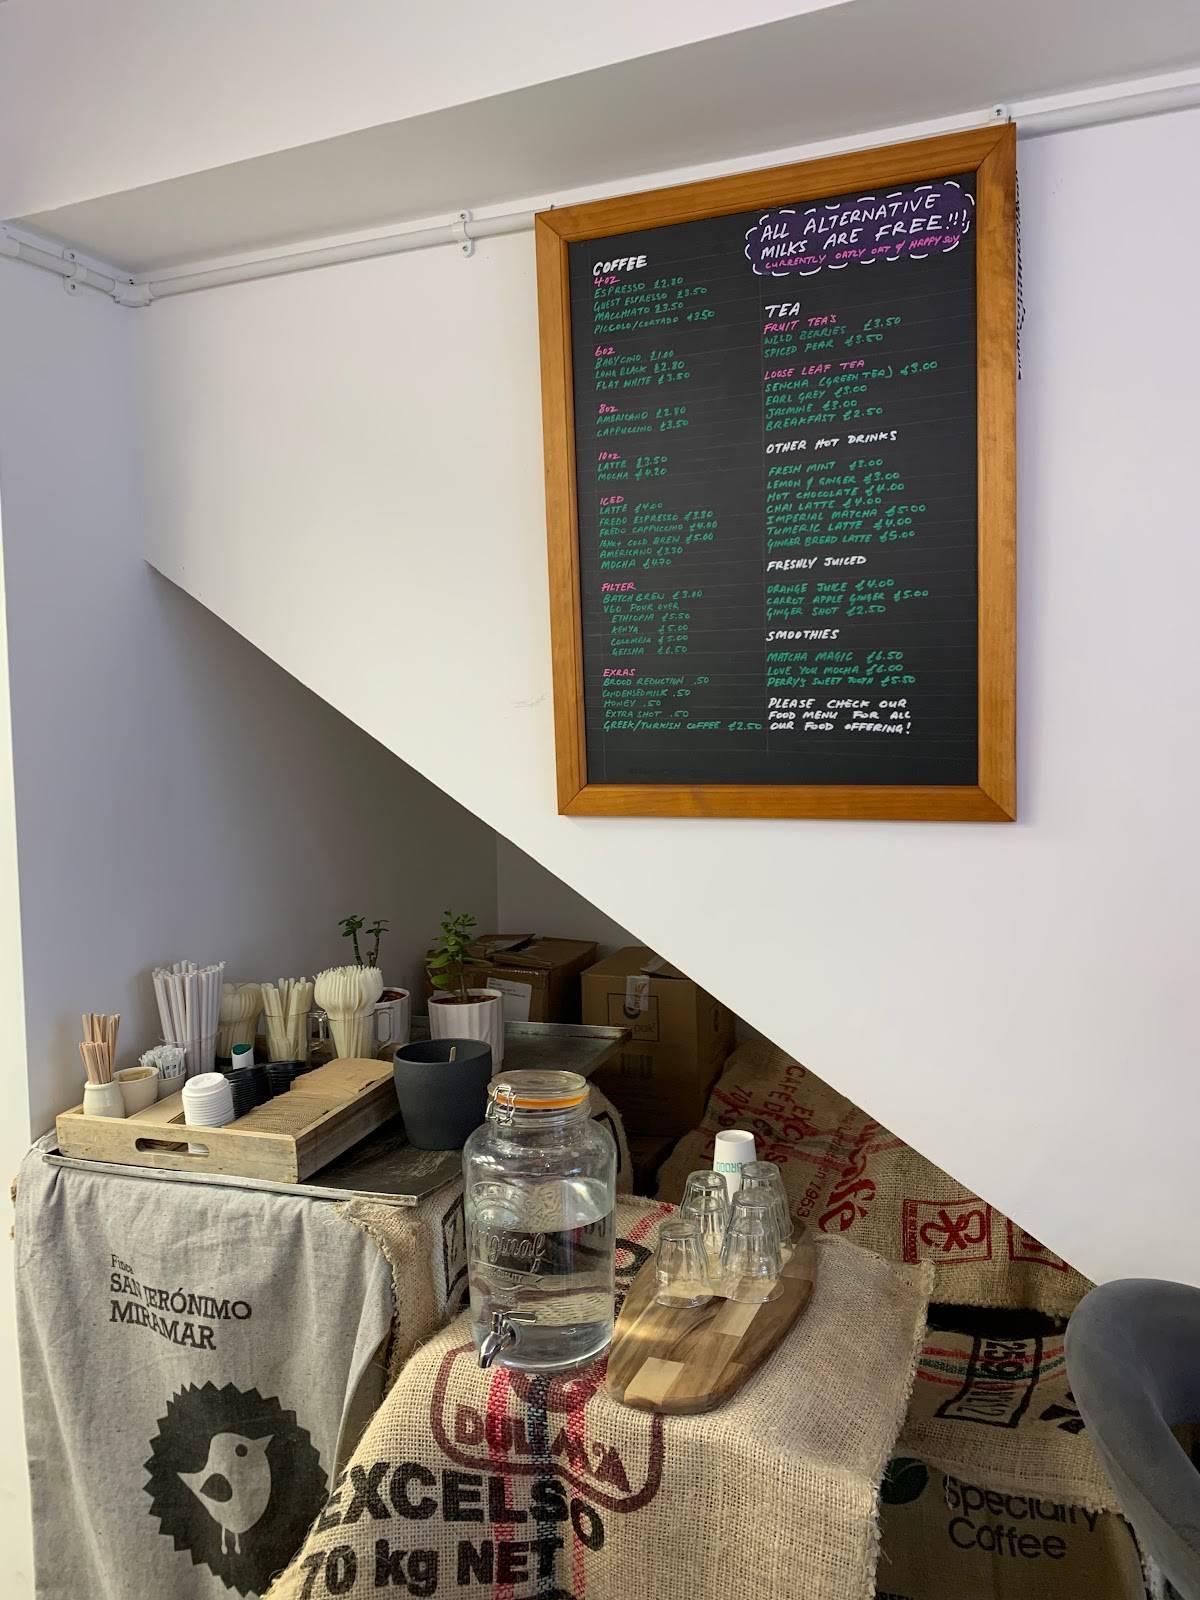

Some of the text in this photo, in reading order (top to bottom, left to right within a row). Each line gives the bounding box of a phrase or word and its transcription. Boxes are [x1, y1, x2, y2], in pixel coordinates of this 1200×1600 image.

[761, 194, 941, 242] ALL ALTERNATIVE
[761, 240, 807, 260] MILKS
[823, 227, 863, 249] ARE
[765, 235, 960, 269] CURRENTLY OATLY OAT HAPPY SOY
[593, 255, 647, 276] COFFEE
[594, 283, 645, 299] ESPRESSO
[593, 287, 707, 312] GUEST ESPRESSO £3.50
[594, 302, 684, 321] MACCHIATO £3.50
[765, 302, 800, 318] TEA
[763, 320, 799, 334] FRUIT
[764, 316, 901, 345] WILD BERRIES £3.50
[763, 347, 797, 358] SPICED
[804, 340, 834, 352] PEAR
[764, 360, 864, 380] LOOSE LEAF TEA
[596, 380, 618, 390] FLAT
[624, 376, 651, 388] WHITE
[765, 379, 809, 392] SENCHA
[818, 373, 859, 387] (GREEN
[766, 393, 792, 405] EARL
[799, 390, 825, 404] GREY
[766, 404, 813, 419] JASMINE
[660, 420, 688, 431] £3.50
[765, 407, 883, 431] BREAKFAST £2.50
[766, 430, 897, 454] OTHER HOT DRINKS
[598, 461, 627, 471] LATTE
[768, 461, 836, 476] FRESH MINT
[598, 472, 628, 480] MOCHA
[768, 480, 800, 489] LEMON
[600, 496, 624, 505] ICED
[767, 492, 789, 502] HOT
[796, 487, 859, 499] CHOCOLATE
[600, 504, 627, 514] LATTE
[766, 503, 792, 513] CHAI
[798, 500, 835, 511] LATTE
[634, 514, 678, 523] ESPRESSO
[766, 513, 823, 525] IMPERIAL
[832, 509, 877, 519] MATCHA
[767, 523, 820, 535] TUMERIC
[828, 521, 863, 531] LATTE
[805, 535, 837, 547] BREAD
[842, 534, 872, 543] LATTE
[601, 560, 635, 569] MOCHA
[767, 556, 867, 572] FRESHLY JUICED
[601, 582, 636, 591] FILTER
[767, 583, 808, 593] ORANGE
[816, 582, 848, 592] JUICE
[603, 594, 632, 603] BATCH
[767, 597, 805, 605] CARROT
[813, 595, 844, 604] APPLE
[850, 592, 885, 605] GINGER
[767, 605, 886, 620] GINGER SHOT £2.50
[766, 629, 839, 641] SMOOTHIES
[767, 652, 808, 662] MATCHA
[815, 651, 853, 662] MAGIC
[603, 668, 635, 677] EXRAS
[768, 666, 791, 675] LOVE
[800, 665, 818, 674] YOU
[824, 665, 859, 674] MOCHA
[603, 678, 632, 686] BROOD
[694, 676, 709, 685] .50
[812, 677, 842, 685] SWEET
[673, 689, 691, 697] .50
[768, 698, 907, 709] PLEASE CHECK OUR
[605, 710, 633, 718] EXTRA
[768, 711, 911, 720] FOOD MENU FOR ALL
[770, 722, 911, 735] OUR FOOD OFFERING!
[110, 1273, 143, 1300] SAN
[110, 1300, 216, 1350] MIRAMAR
[947, 1516, 1067, 1559] Coffee
[375, 1538, 438, 1596] kg
[456, 1536, 564, 1586] NET
